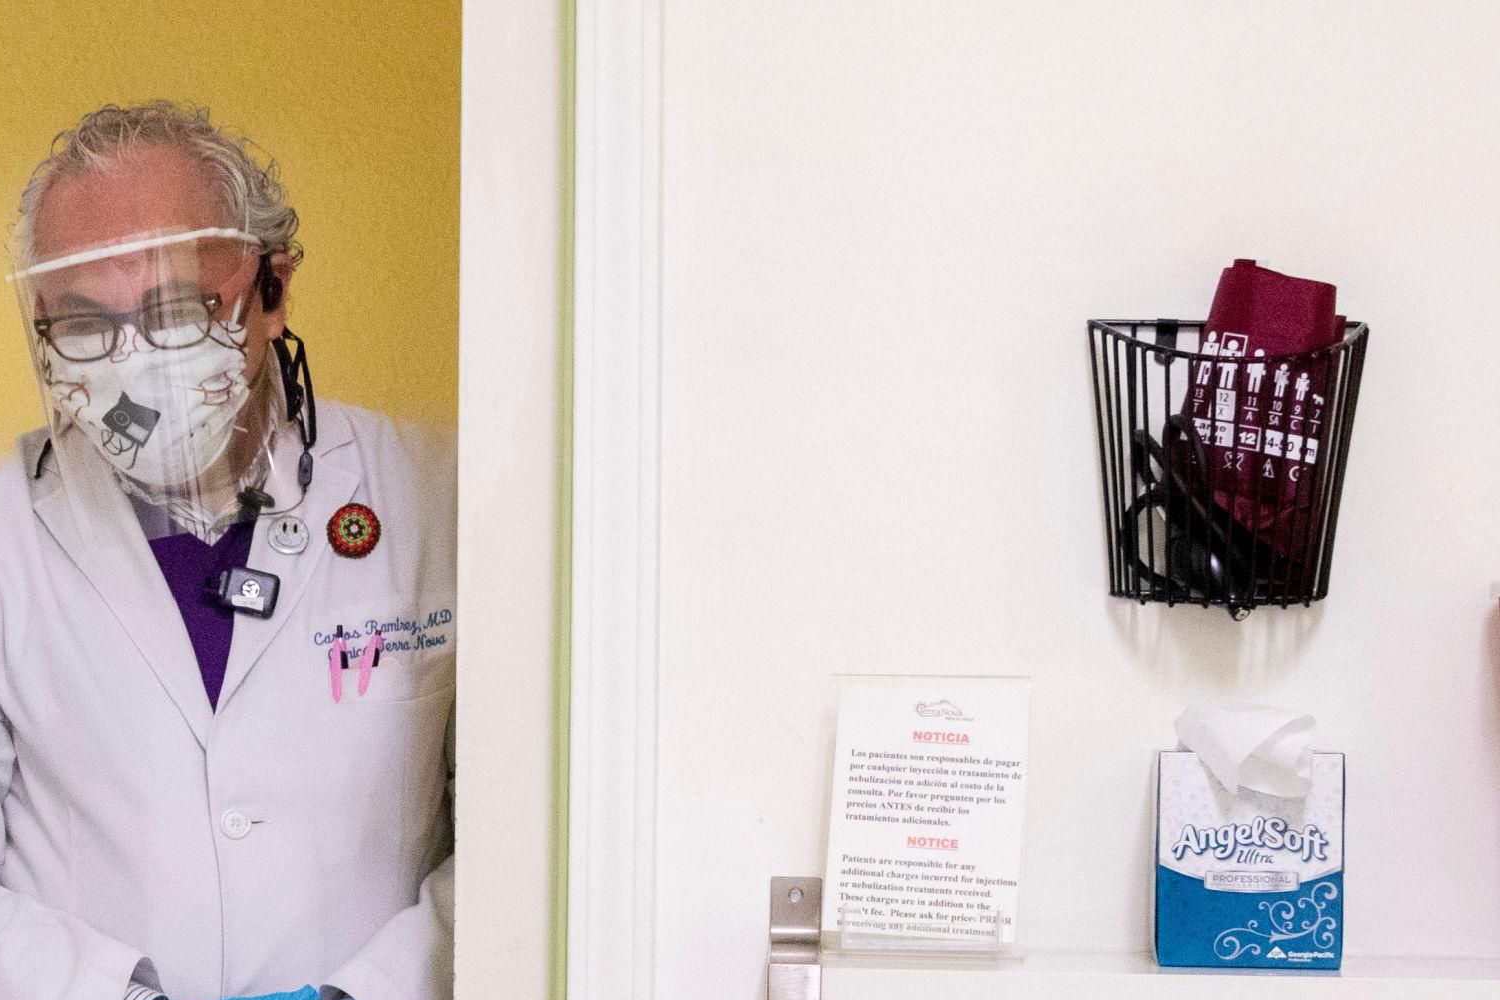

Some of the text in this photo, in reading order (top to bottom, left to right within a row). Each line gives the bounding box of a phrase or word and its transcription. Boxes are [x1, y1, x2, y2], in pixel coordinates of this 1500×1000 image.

[1219, 392, 1229, 401] 12
[1247, 396, 1257, 406] 11
[1272, 400, 1283, 411] 10
[1294, 404, 1301, 415] 9
[1245, 411, 1253, 421] A
[1268, 414, 1279, 426] SA
[1238, 431, 1257, 445] 12
[314, 629, 362, 646] Caros
[912, 730, 970, 744] NOTICIA
[851, 749, 866, 757] Los
[868, 751, 908, 760] pacientes
[926, 755, 981, 764] responsables
[995, 760, 1021, 768] pagar
[850, 763, 864, 771] por
[867, 764, 907, 773] cualquier
[909, 765, 949, 776] inyección
[958, 769, 1010, 779] tratamiento
[1011, 772, 1022, 780] de
[849, 775, 902, 785] nebulización
[916, 779, 947, 788] adición
[960, 783, 982, 791] costo
[984, 783, 994, 791] de
[996, 784, 1004, 792] la
[847, 788, 886, 797] consulta.
[888, 789, 903, 797] Por
[905, 790, 928, 799] favor
[930, 794, 974, 803] pregunten
[994, 796, 1006, 804] los
[846, 800, 970, 815] precios ANTES de recibir los
[845, 813, 950, 827] tratamientos adicionales.
[906, 835, 959, 848] NOTICE
[842, 854, 876, 864] Patients
[895, 859, 943, 868] responsible
[945, 861, 958, 869] for
[960, 864, 976, 872] any
[1236, 848, 1275, 865] Ultra
[840, 867, 1018, 887] additional charges incurred for injections
[1212, 875, 1292, 884] PROFESSIONAL
[851, 881, 904, 892] nebulization
[906, 884, 953, 895] treatments
[954, 888, 993, 898] received.
[839, 892, 864, 902] These
[866, 895, 899, 905] charges
[917, 898, 926, 906] in
[928, 899, 964, 908] addition
[977, 902, 991, 911] the
[870, 907, 885, 916] fee.
[890, 908, 917, 919] Please
[919, 911, 934, 919] ask
[936, 912, 949, 920] for
